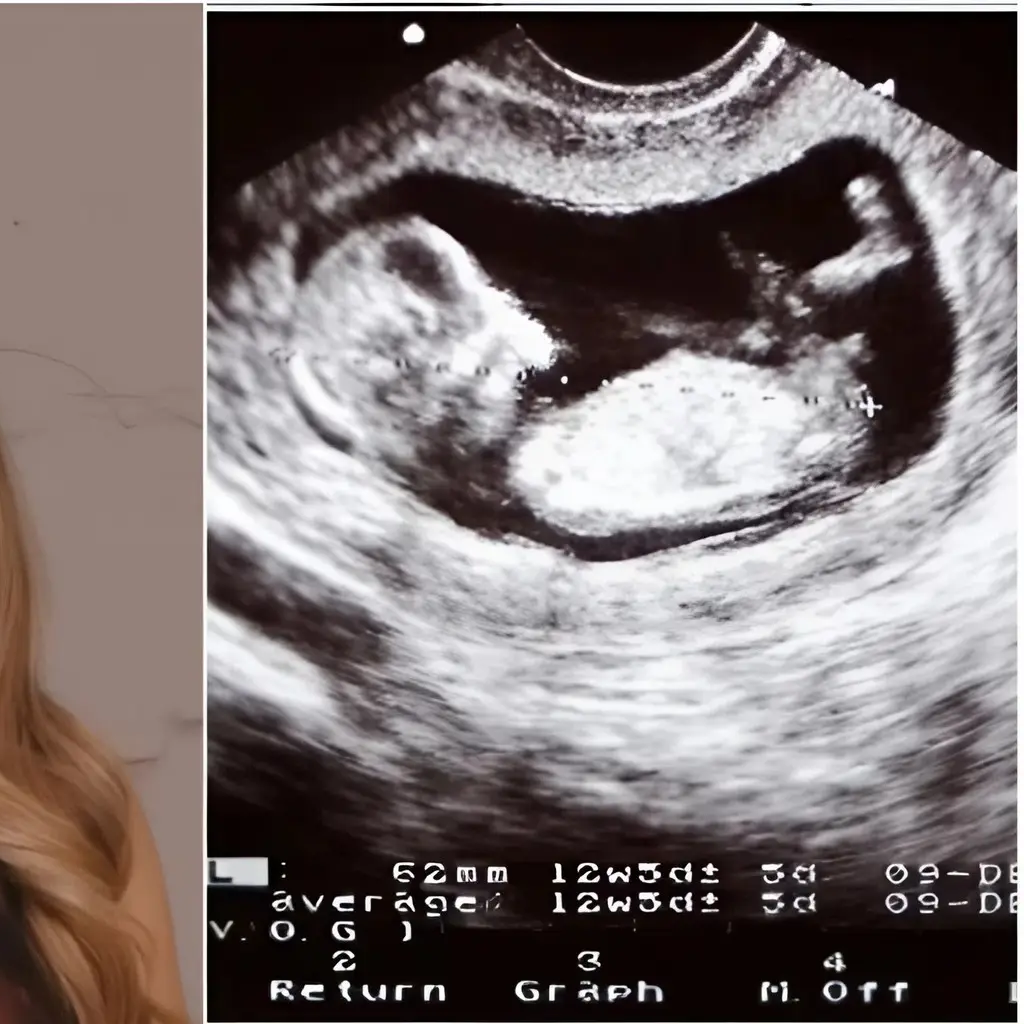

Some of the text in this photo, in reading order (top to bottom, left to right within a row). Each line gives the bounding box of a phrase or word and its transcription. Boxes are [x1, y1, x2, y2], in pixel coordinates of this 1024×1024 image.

[209, 860, 233, 883] L
[392, 861, 508, 884] 62mm
[332, 949, 847, 972] 2 3 4
[270, 979, 446, 1002] Return
[514, 979, 664, 1002] Graph
